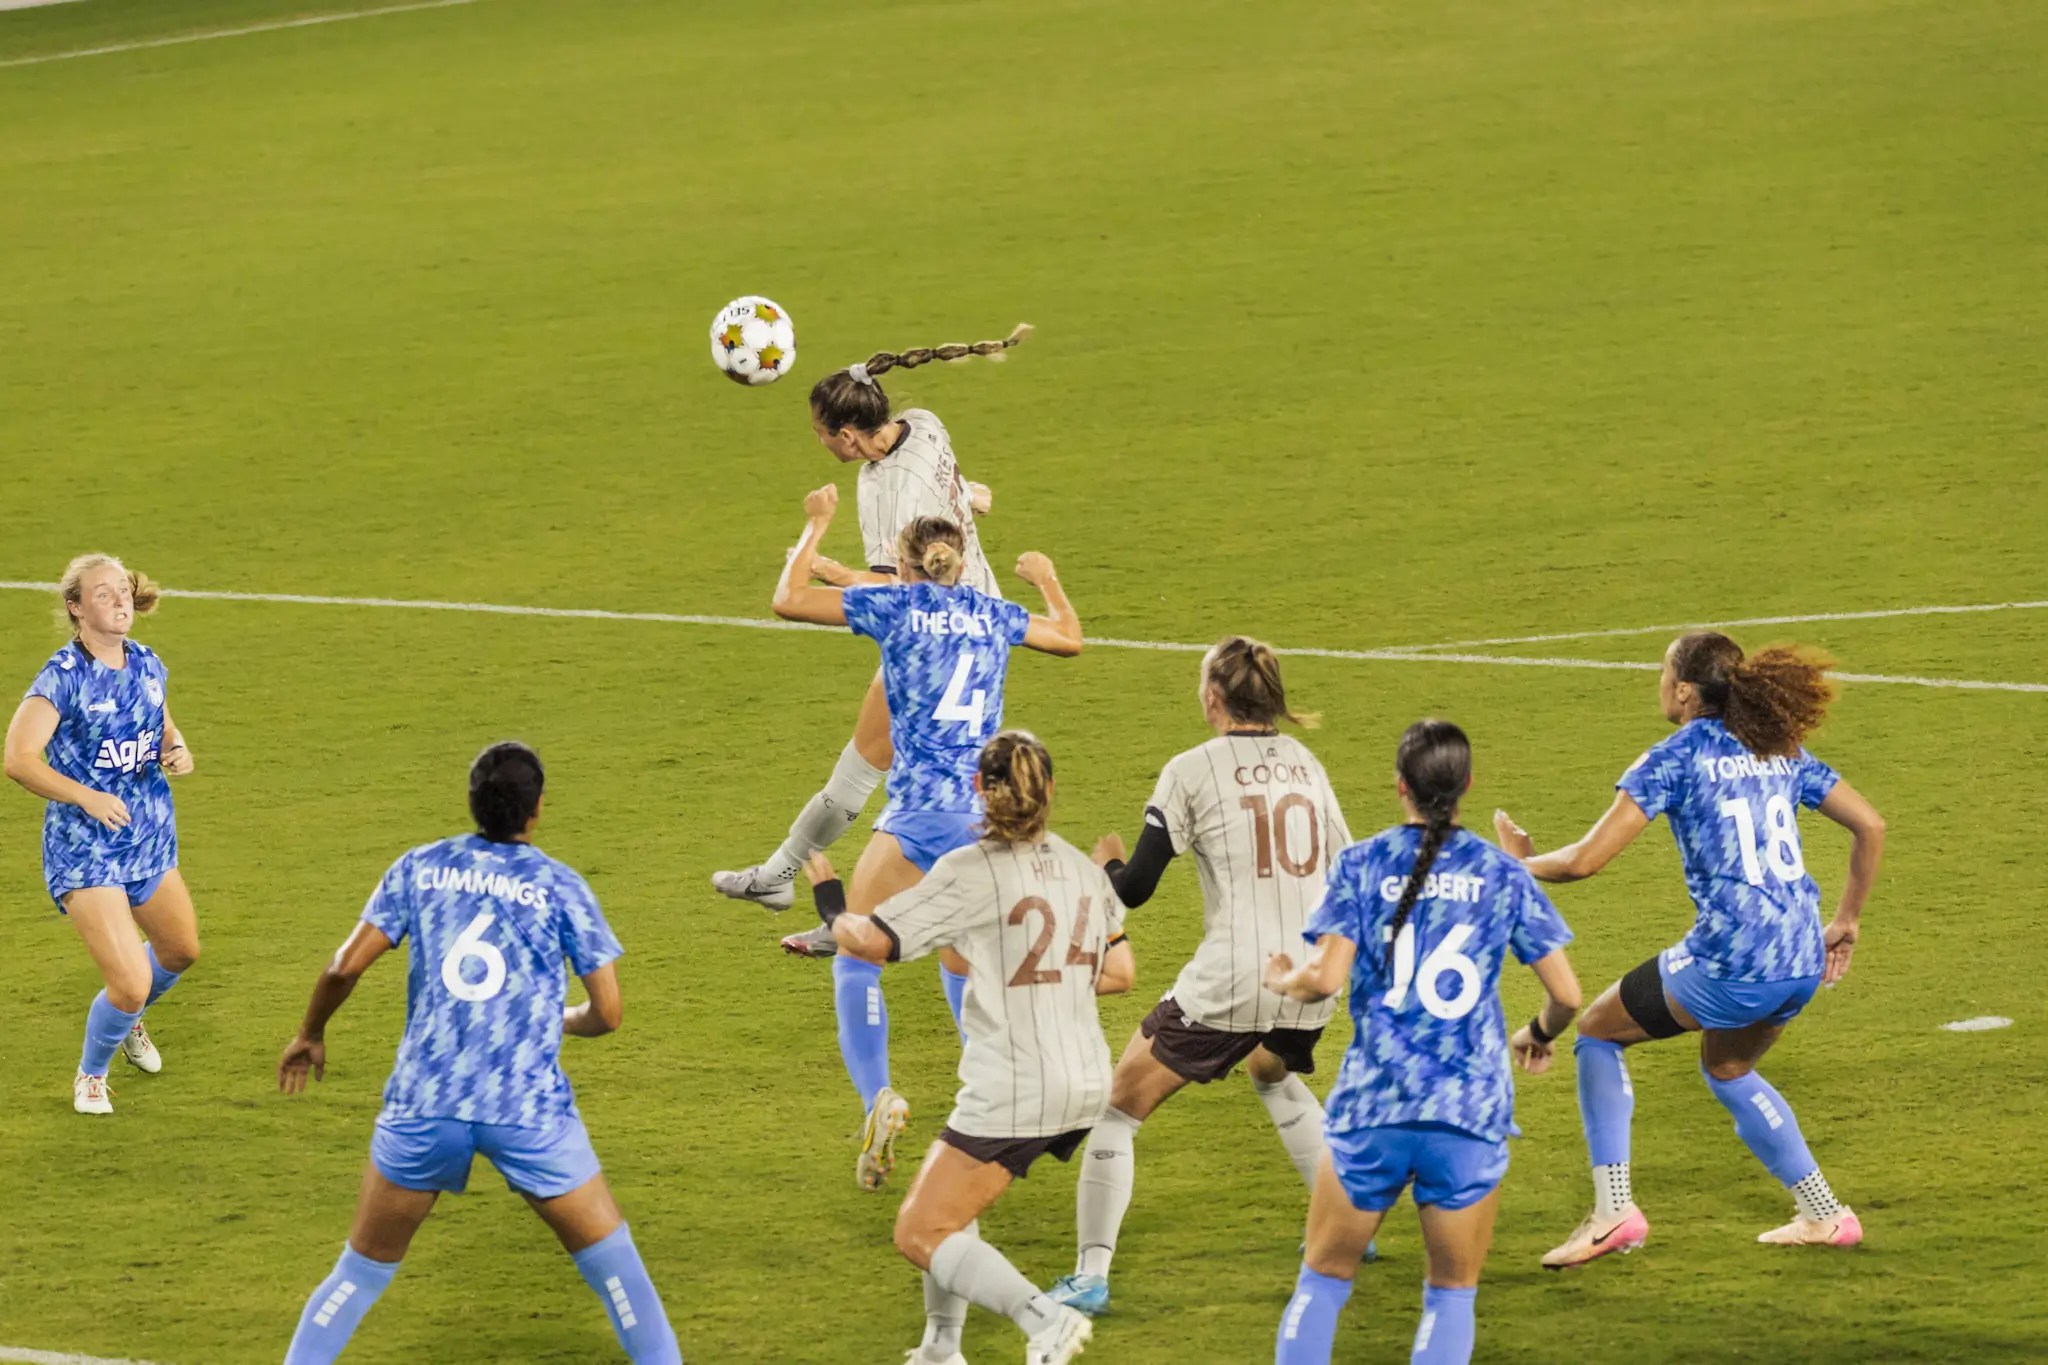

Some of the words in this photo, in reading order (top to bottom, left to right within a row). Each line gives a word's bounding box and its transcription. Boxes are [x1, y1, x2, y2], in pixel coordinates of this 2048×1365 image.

[932, 654, 986, 737] 4
[1234, 763, 1312, 786] COOKE
[1240, 792, 1320, 878] 10
[1720, 794, 1805, 885] 18
[416, 867, 549, 909] CUMMINGS
[1380, 872, 1485, 902] GIBERT
[441, 913, 506, 1000] 6
[1008, 895, 1098, 987] 24
[1382, 922, 1482, 1020] 16
